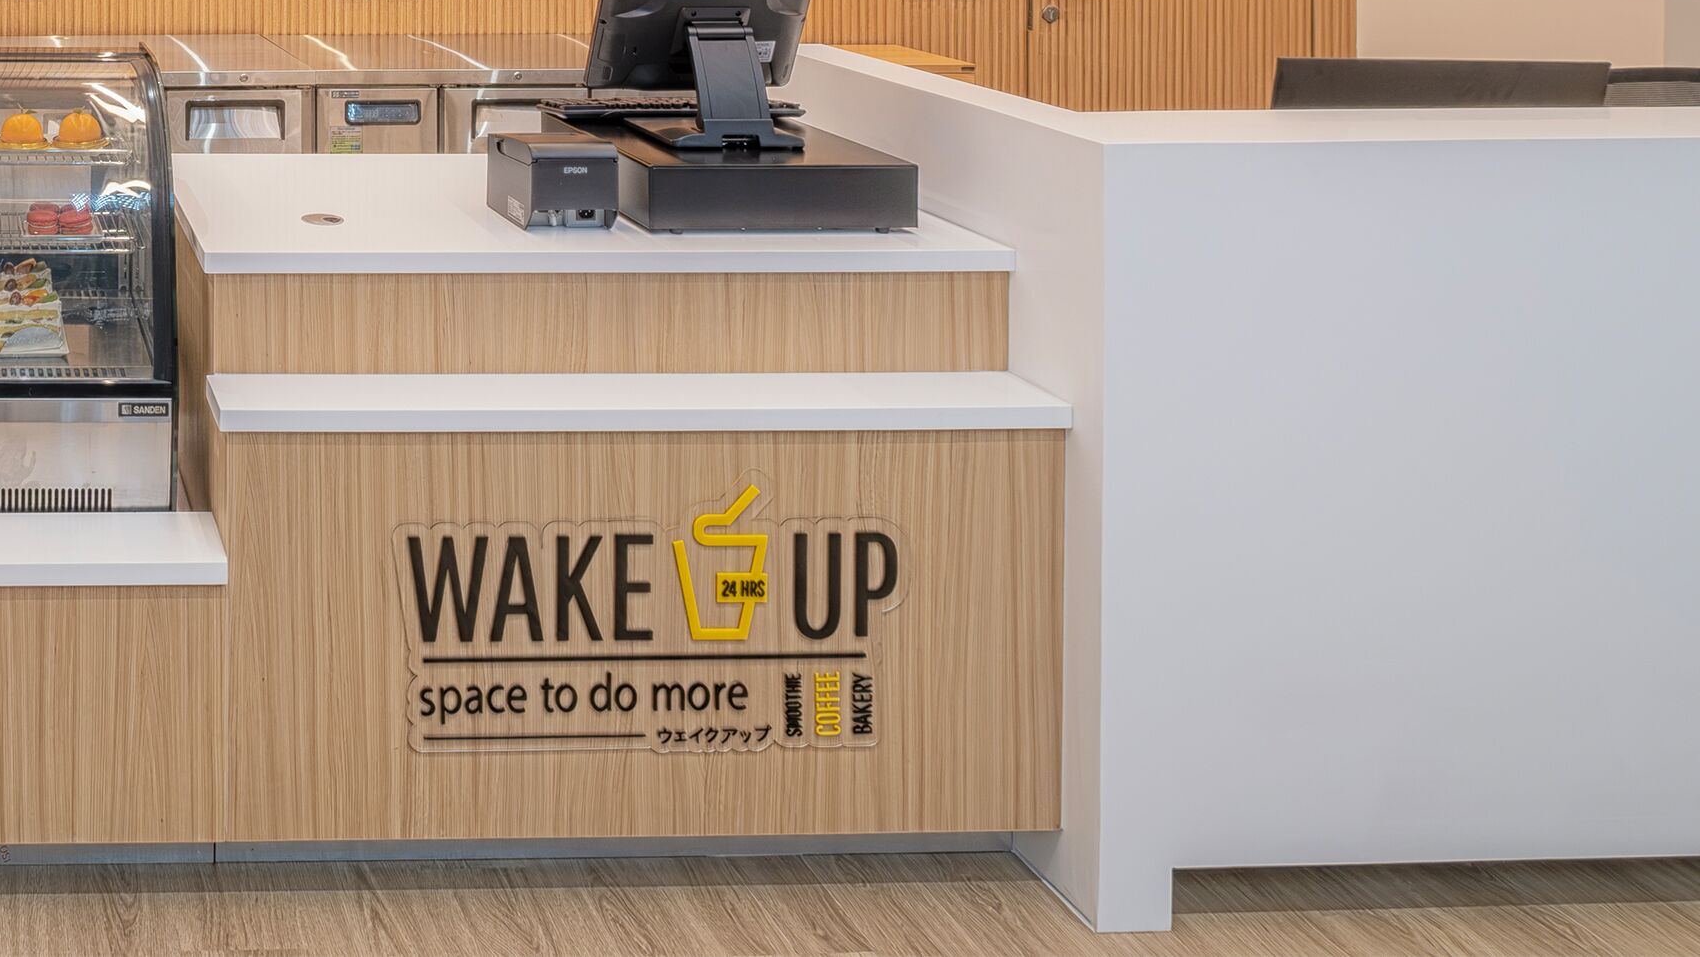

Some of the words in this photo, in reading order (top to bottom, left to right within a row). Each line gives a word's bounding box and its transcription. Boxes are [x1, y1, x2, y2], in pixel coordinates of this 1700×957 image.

[563, 166, 588, 174] EPSON
[133, 405, 166, 414] SANDEN
[407, 533, 654, 643] WAKE
[793, 531, 899, 639] UP
[721, 579, 737, 597] 24
[740, 579, 766, 597] HRS
[419, 683, 528, 724] space
[541, 677, 578, 714] to
[590, 672, 638, 713] do
[652, 679, 749, 712] more
[785, 672, 803, 737] SMOOTHIE
[814, 670, 842, 737] COFFEE
[851, 672, 874, 735] BAKERY
[657, 724, 773, 744] ウェイクアップ
